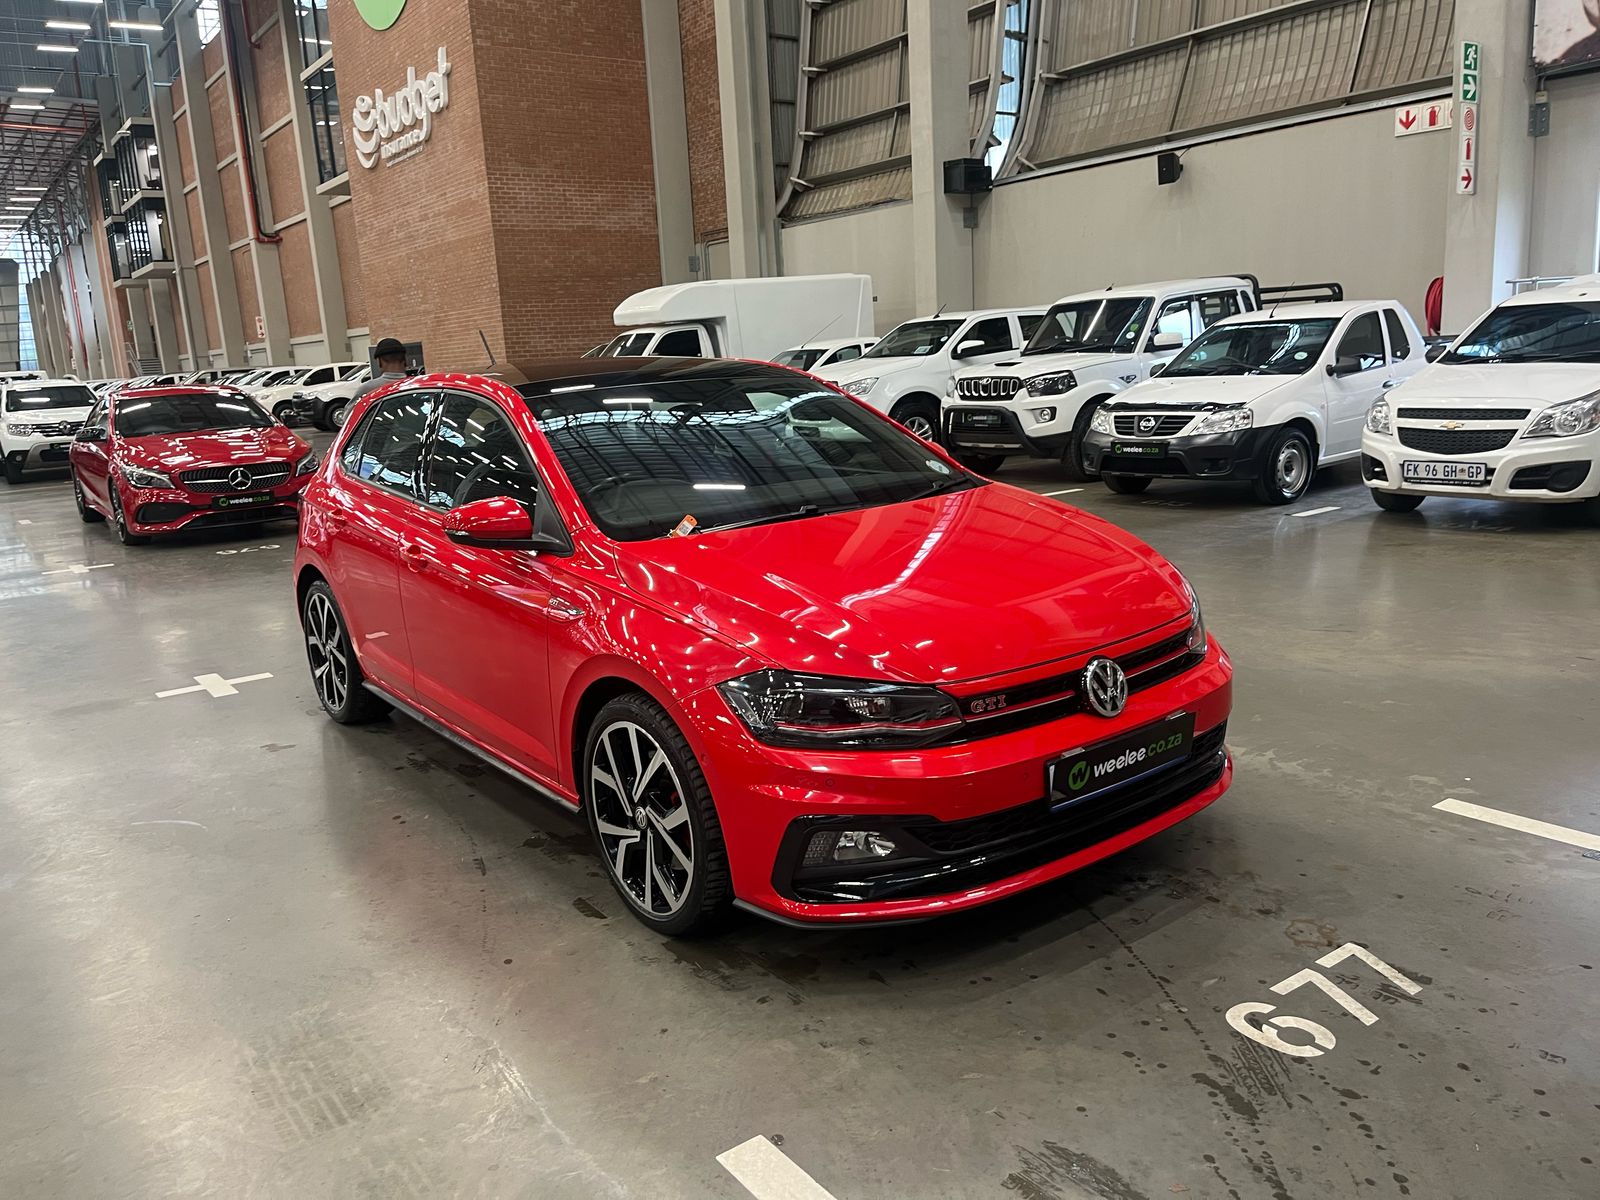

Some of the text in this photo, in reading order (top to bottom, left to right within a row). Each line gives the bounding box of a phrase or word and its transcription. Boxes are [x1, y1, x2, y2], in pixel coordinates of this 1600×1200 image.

[375, 46, 452, 142] budget
[1406, 463, 1482, 479] FK 96 GH GP
[970, 694, 1007, 714] GTI
[1093, 732, 1183, 778] weelee.co.za
[1225, 942, 1424, 1058] 677
